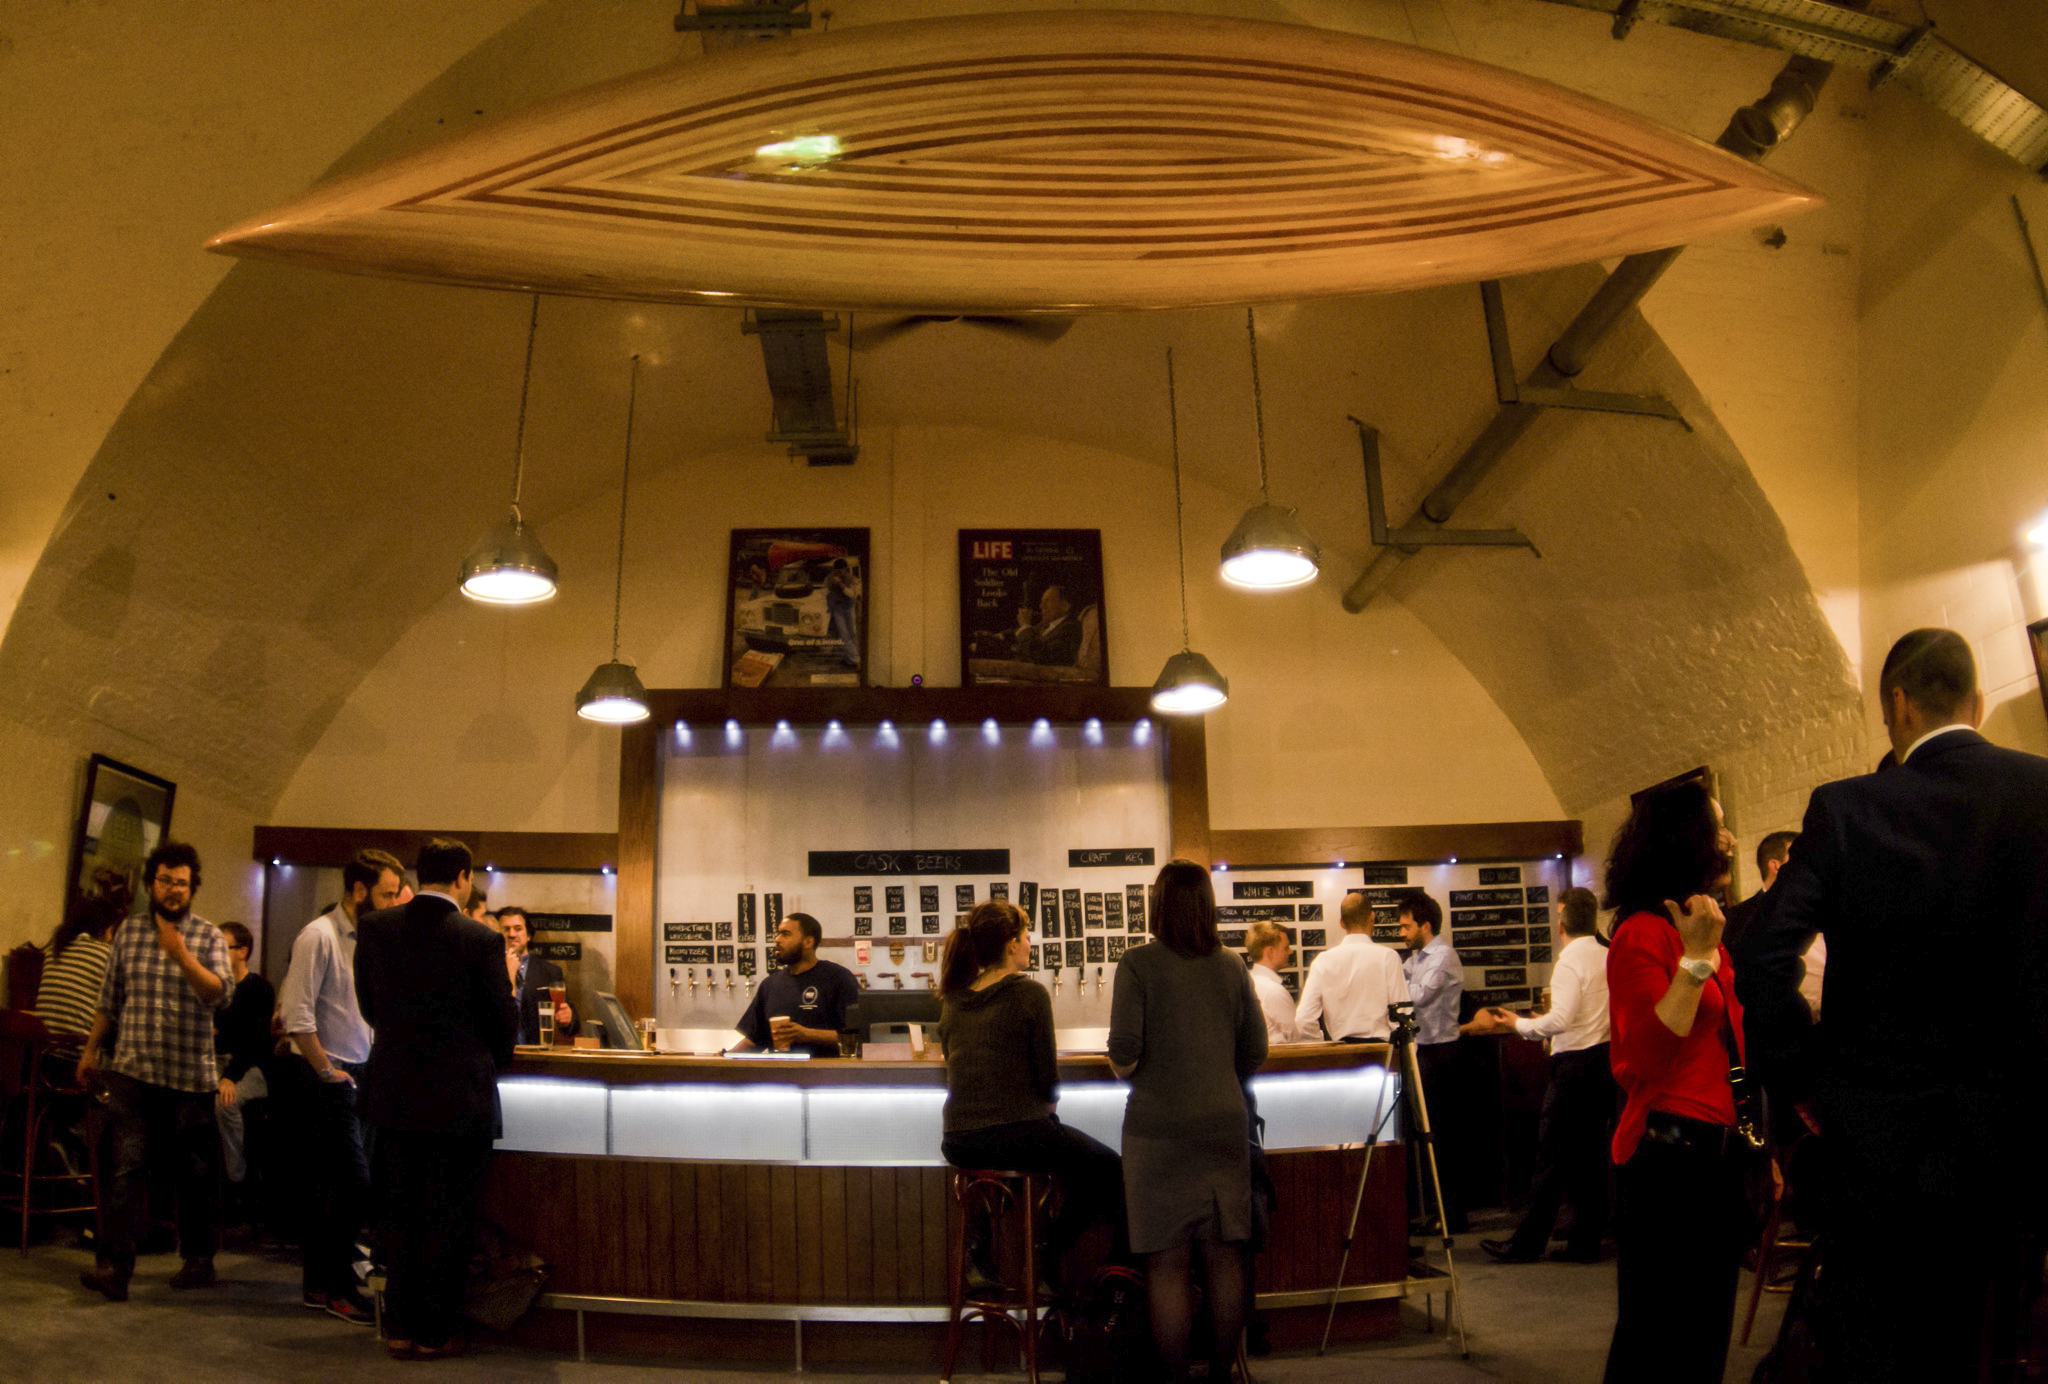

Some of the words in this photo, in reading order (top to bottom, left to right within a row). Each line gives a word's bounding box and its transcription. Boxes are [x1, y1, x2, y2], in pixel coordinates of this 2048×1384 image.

[973, 541, 1013, 559] LIFE
[983, 568, 999, 577] The
[1001, 568, 1018, 577] Old
[974, 578, 1004, 587] Soldier
[982, 588, 1007, 597] Looks
[977, 599, 998, 608] Back
[854, 853, 901, 872] CASK
[914, 854, 961, 871] BEERS
[1080, 852, 1112, 863] CRAFT
[1125, 852, 1144, 865] KEG
[1242, 886, 1271, 898] WHITE
[1276, 886, 1301, 897] WINE
